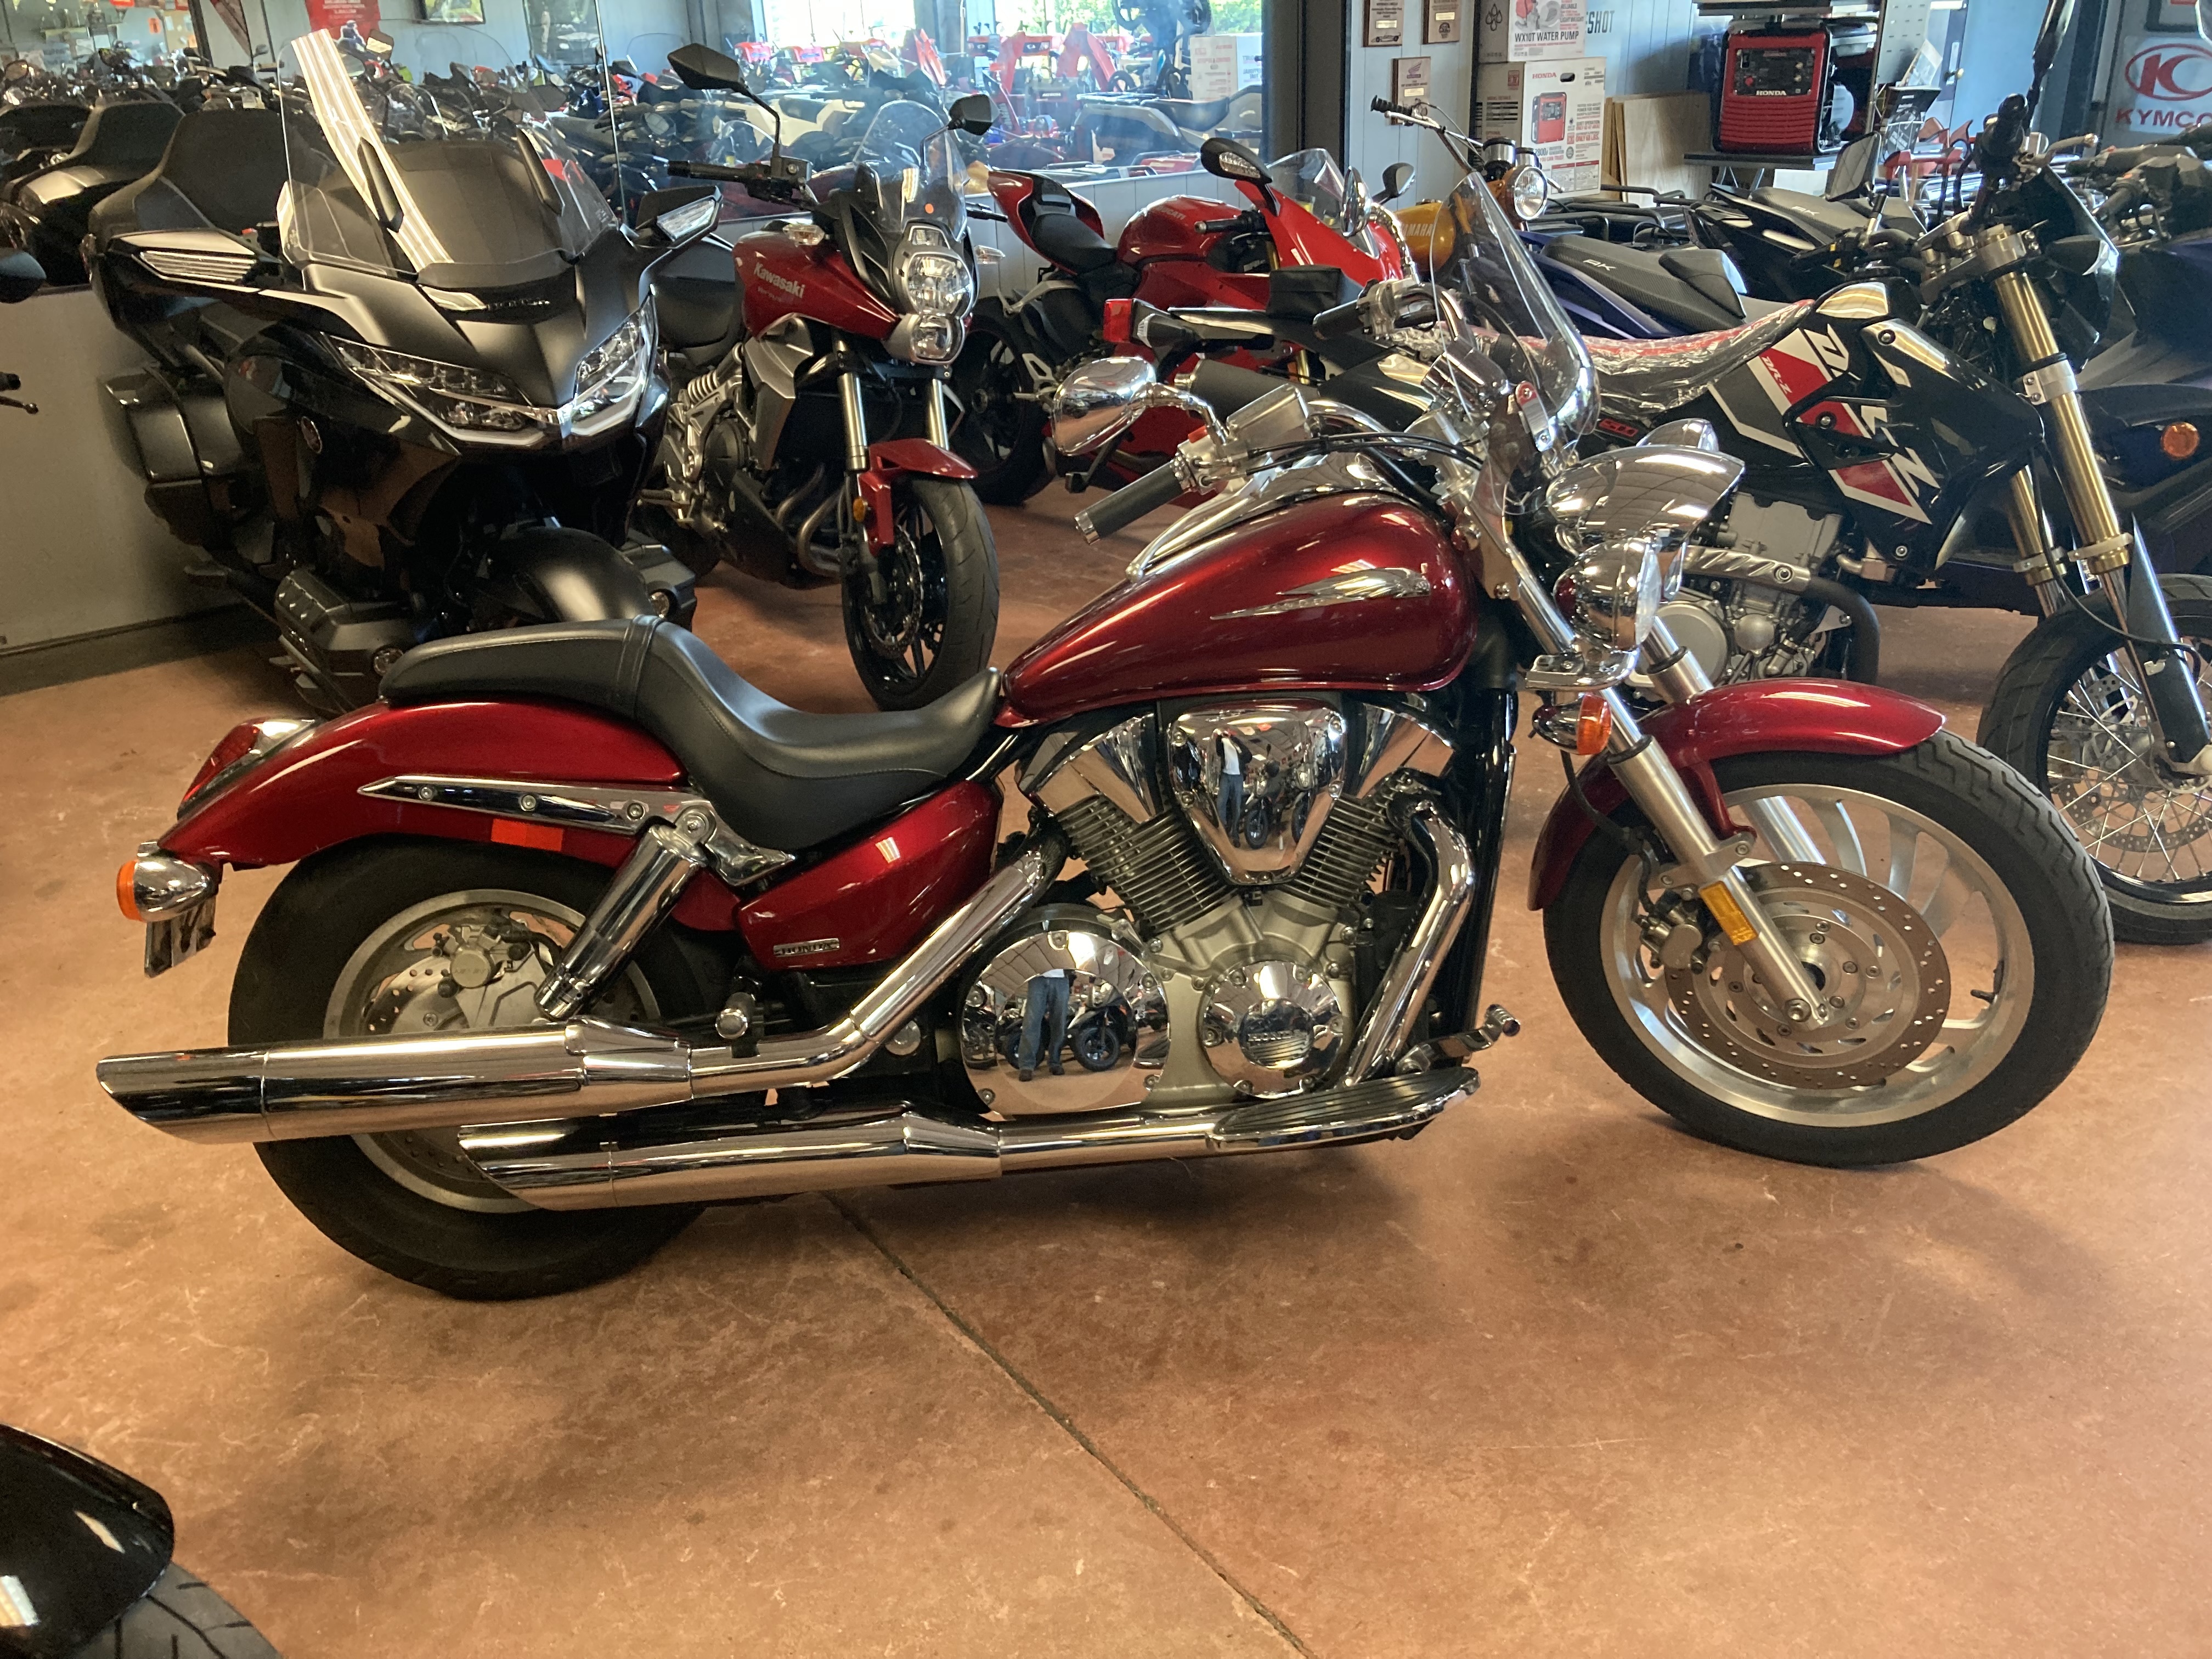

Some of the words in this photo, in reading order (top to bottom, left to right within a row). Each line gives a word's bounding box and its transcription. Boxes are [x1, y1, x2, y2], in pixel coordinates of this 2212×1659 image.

[1515, 32, 1535, 42] WX10T
[1537, 32, 1559, 42] WATER
[1561, 31, 1579, 41] PUMP
[1401, 223, 1434, 236] AMAHA
[754, 262, 805, 298] Kawasaki
[1762, 356, 1792, 394] DR-Z
[781, 943, 833, 955] HONDA
[1248, 1029, 1307, 1042] HONDA
